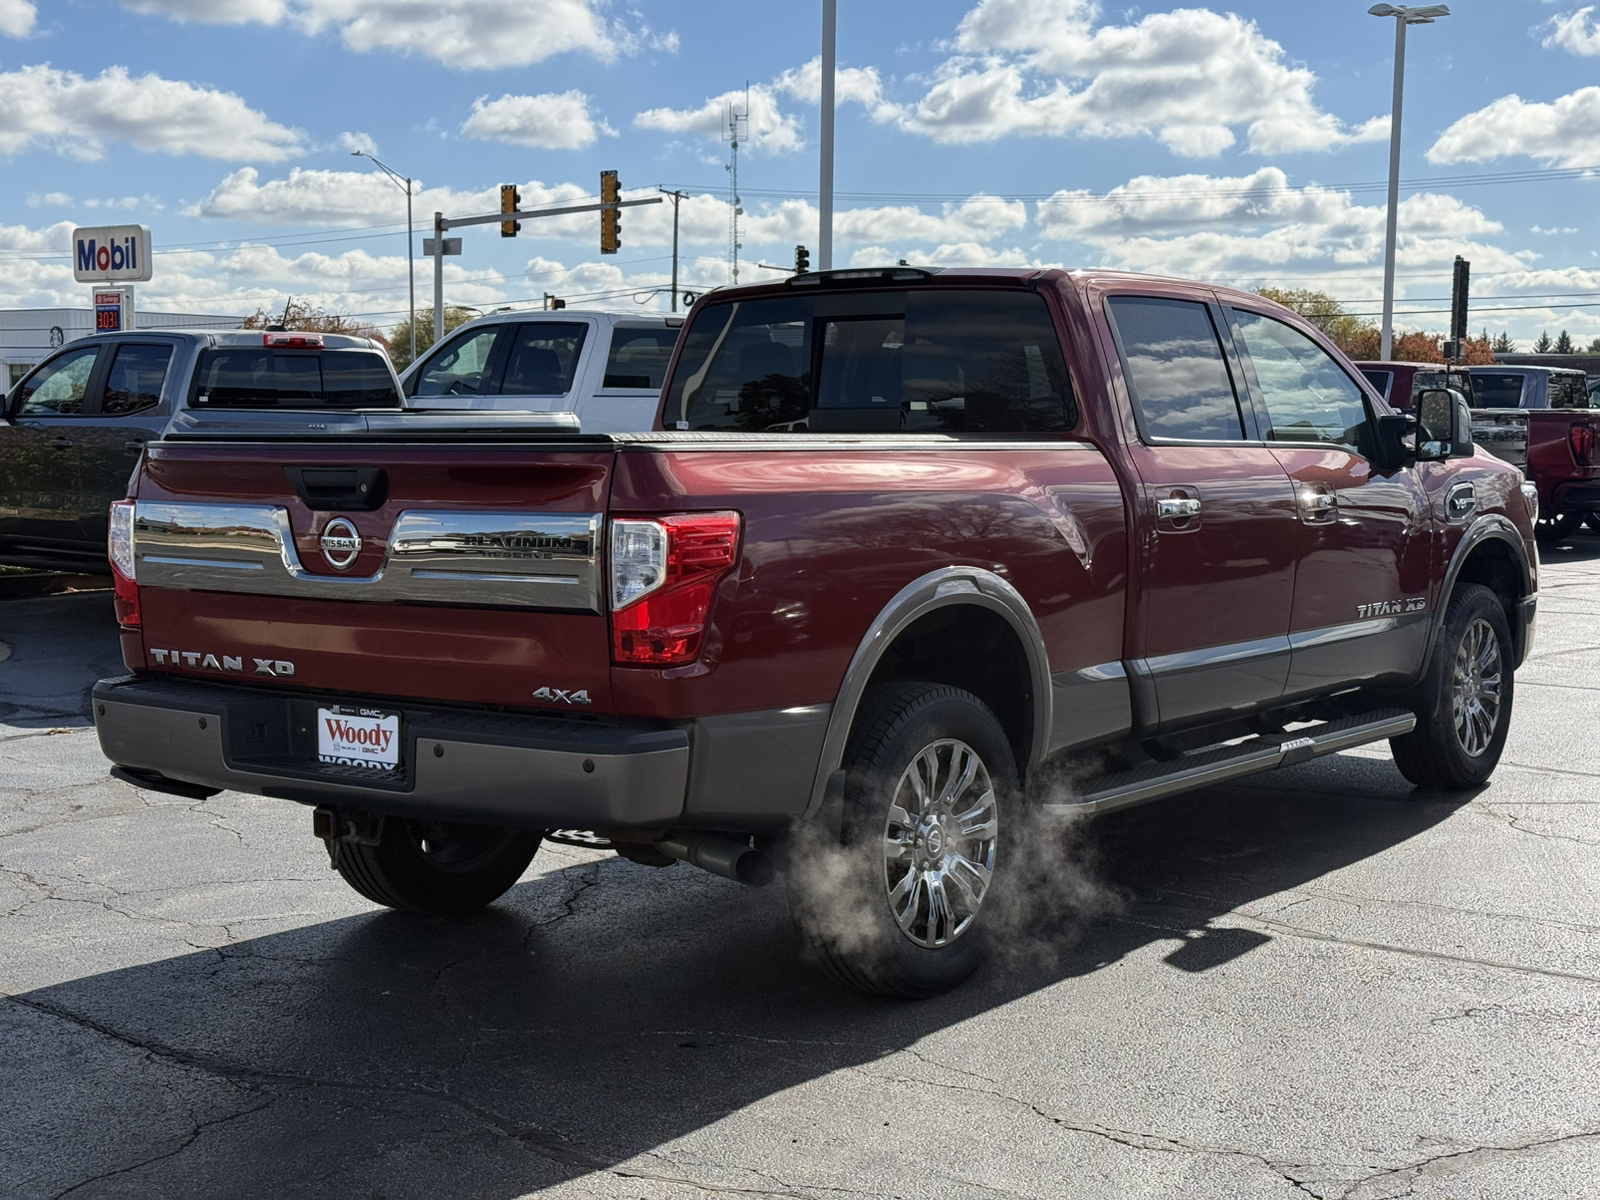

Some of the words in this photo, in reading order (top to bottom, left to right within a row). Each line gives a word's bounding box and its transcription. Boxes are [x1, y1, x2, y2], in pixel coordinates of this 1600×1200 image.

[78, 236, 137, 271] Mobil
[322, 539, 356, 549] NISSAN
[464, 535, 573, 549] PLATINUM
[482, 551, 553, 560] RESERVE
[1356, 600, 1402, 619] TITAN
[1405, 597, 1426, 612] XD
[150, 648, 244, 673] TITAN
[252, 658, 295, 677] XD
[360, 708, 381, 717] GMC
[325, 718, 394, 753] Woody
[362, 747, 379, 755] GMC
